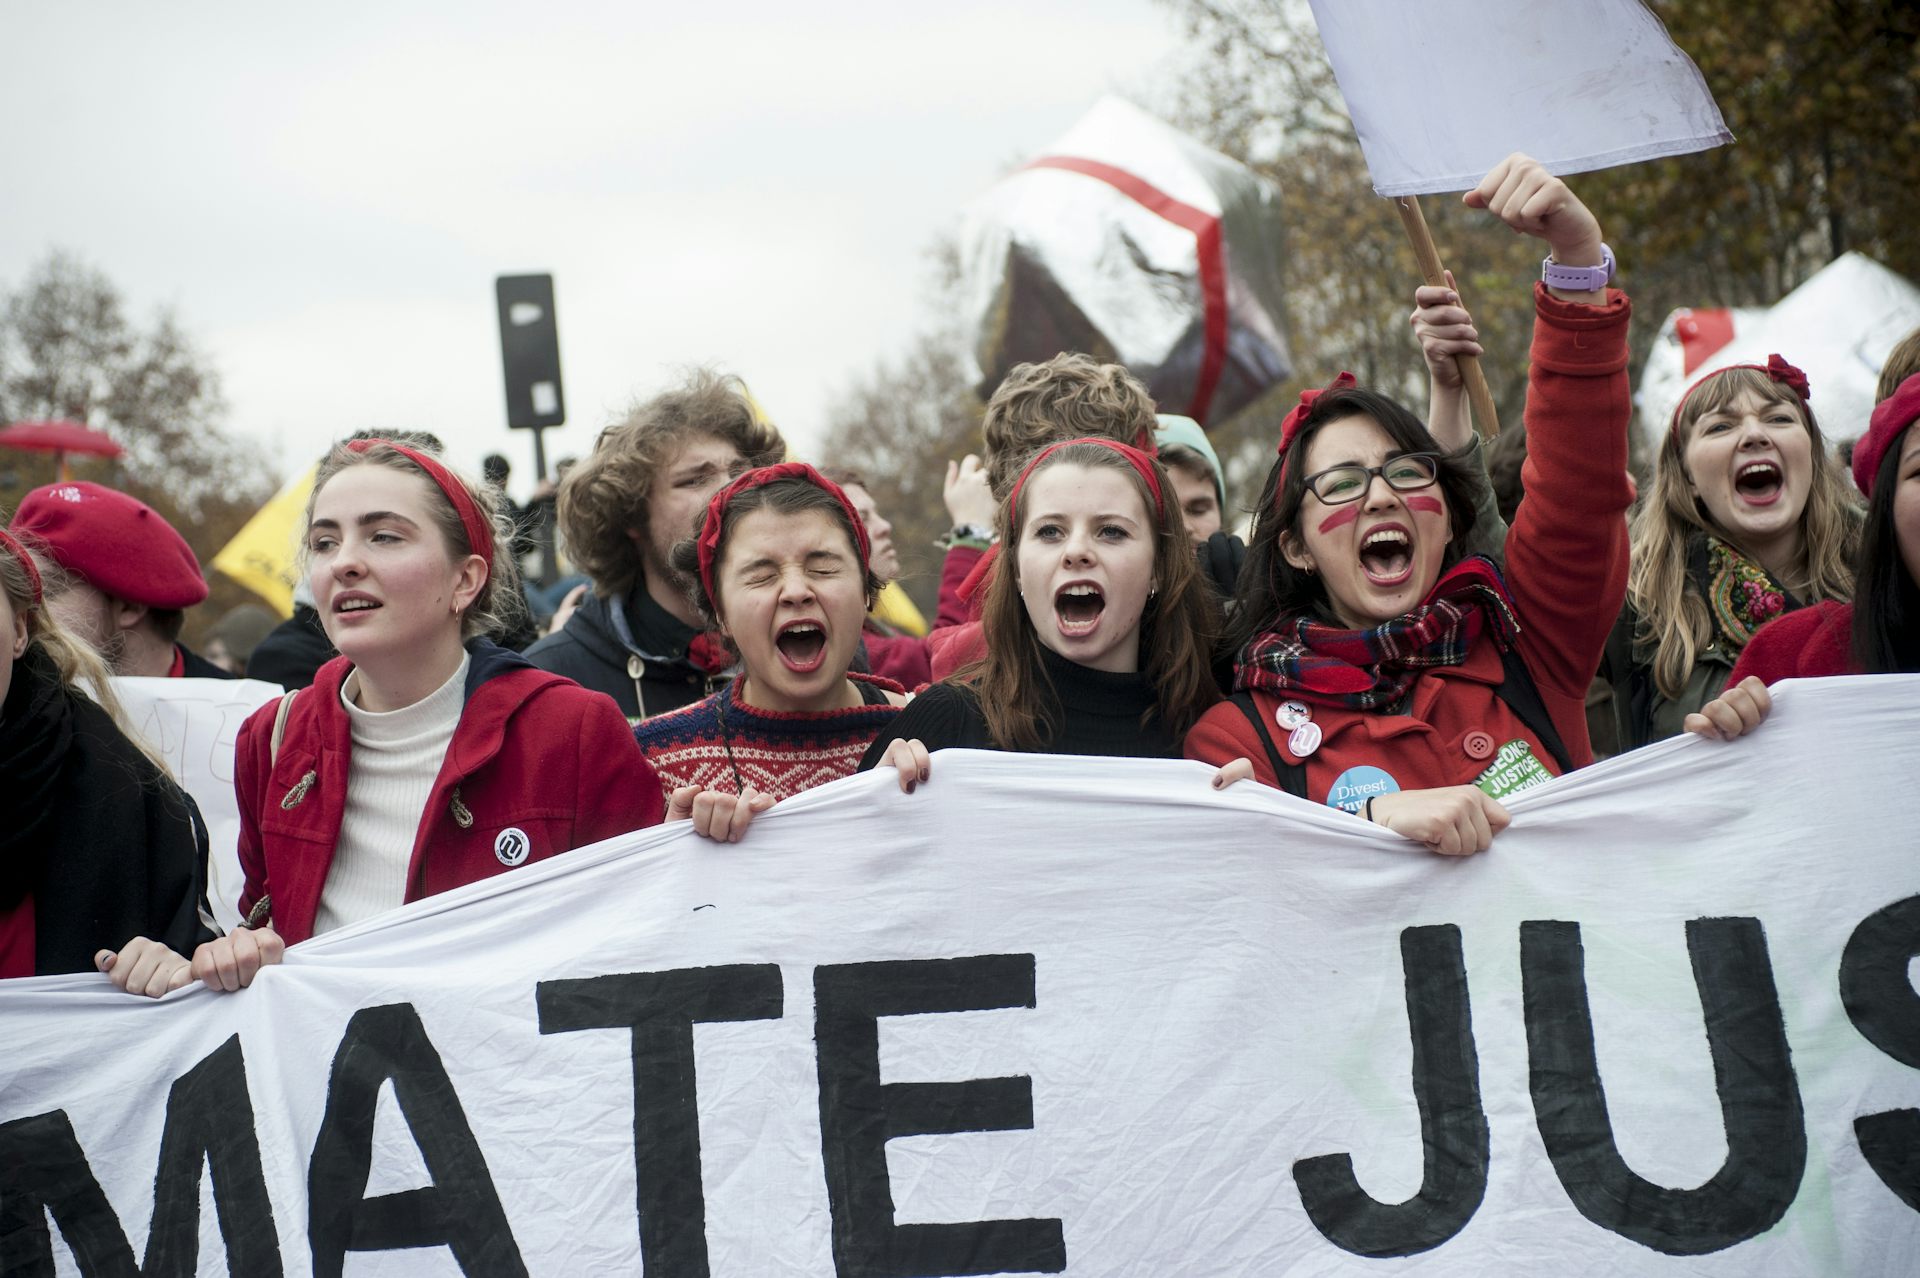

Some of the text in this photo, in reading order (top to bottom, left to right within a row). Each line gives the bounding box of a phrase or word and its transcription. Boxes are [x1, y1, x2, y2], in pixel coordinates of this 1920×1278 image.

[1337, 778, 1388, 800] Divest
[1491, 755, 1540, 795] JUSTICE
[0, 953, 1067, 1278] MATE
